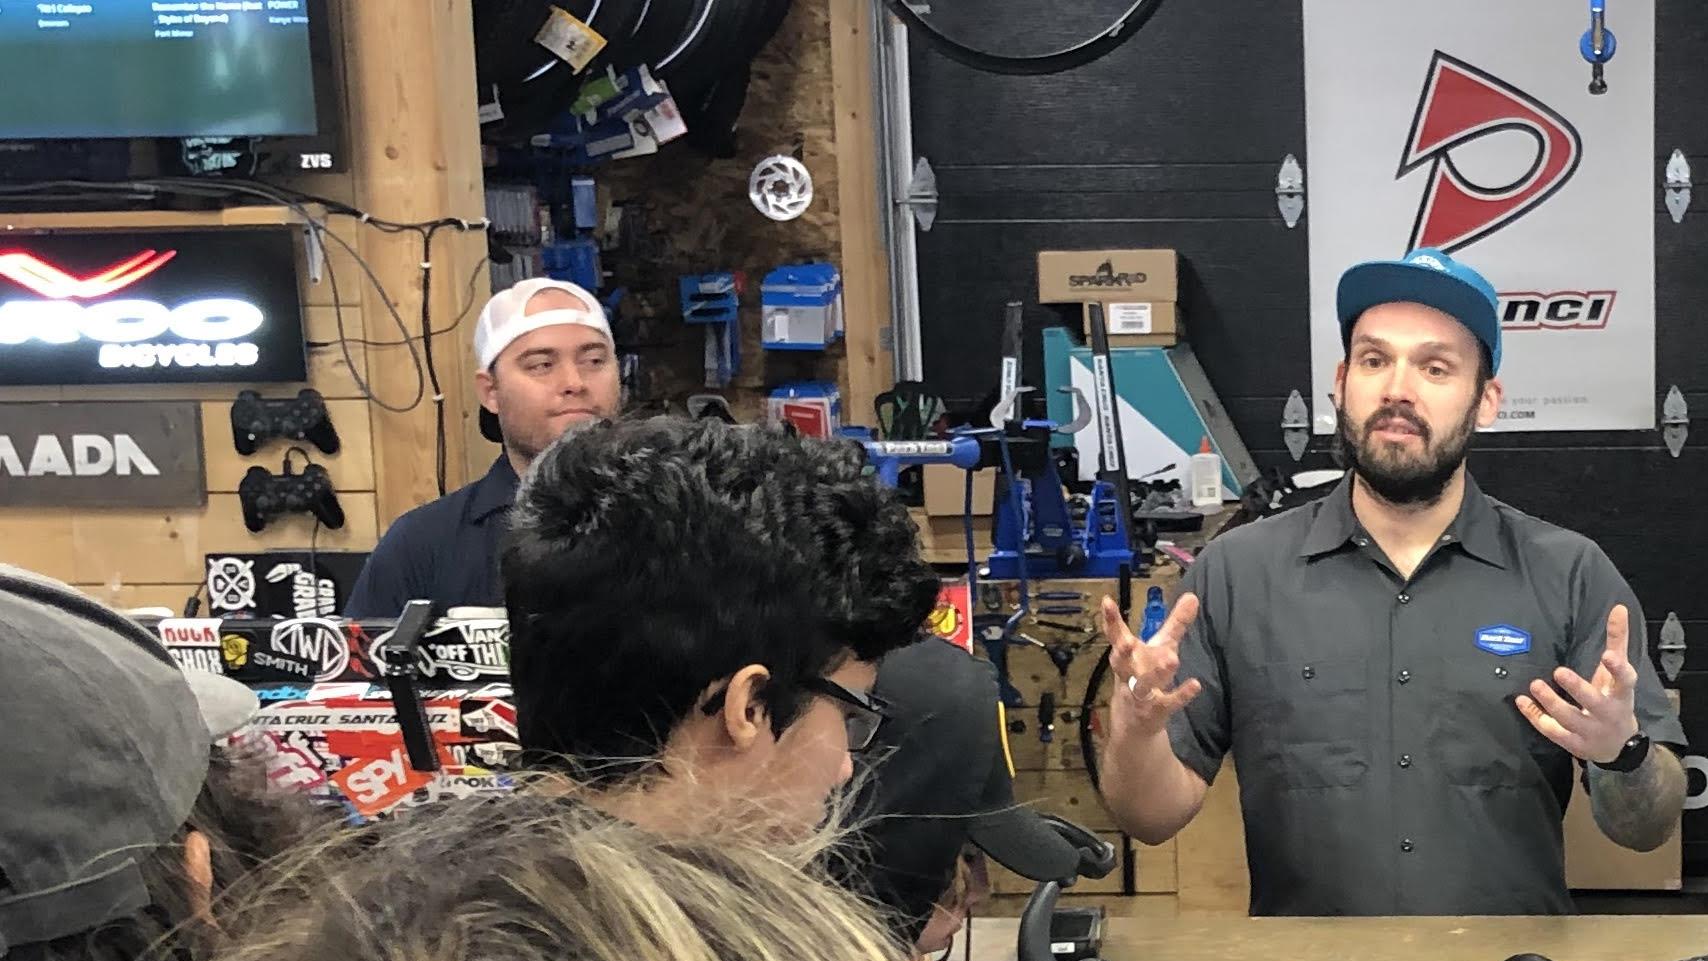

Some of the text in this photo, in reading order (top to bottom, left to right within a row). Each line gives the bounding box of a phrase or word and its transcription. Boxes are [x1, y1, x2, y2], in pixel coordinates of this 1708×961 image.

[98, 342, 259, 369] BICYCLES
[253, 651, 308, 677] SMITH
[284, 714, 332, 726] CRUZ
[346, 747, 408, 805] SPY
